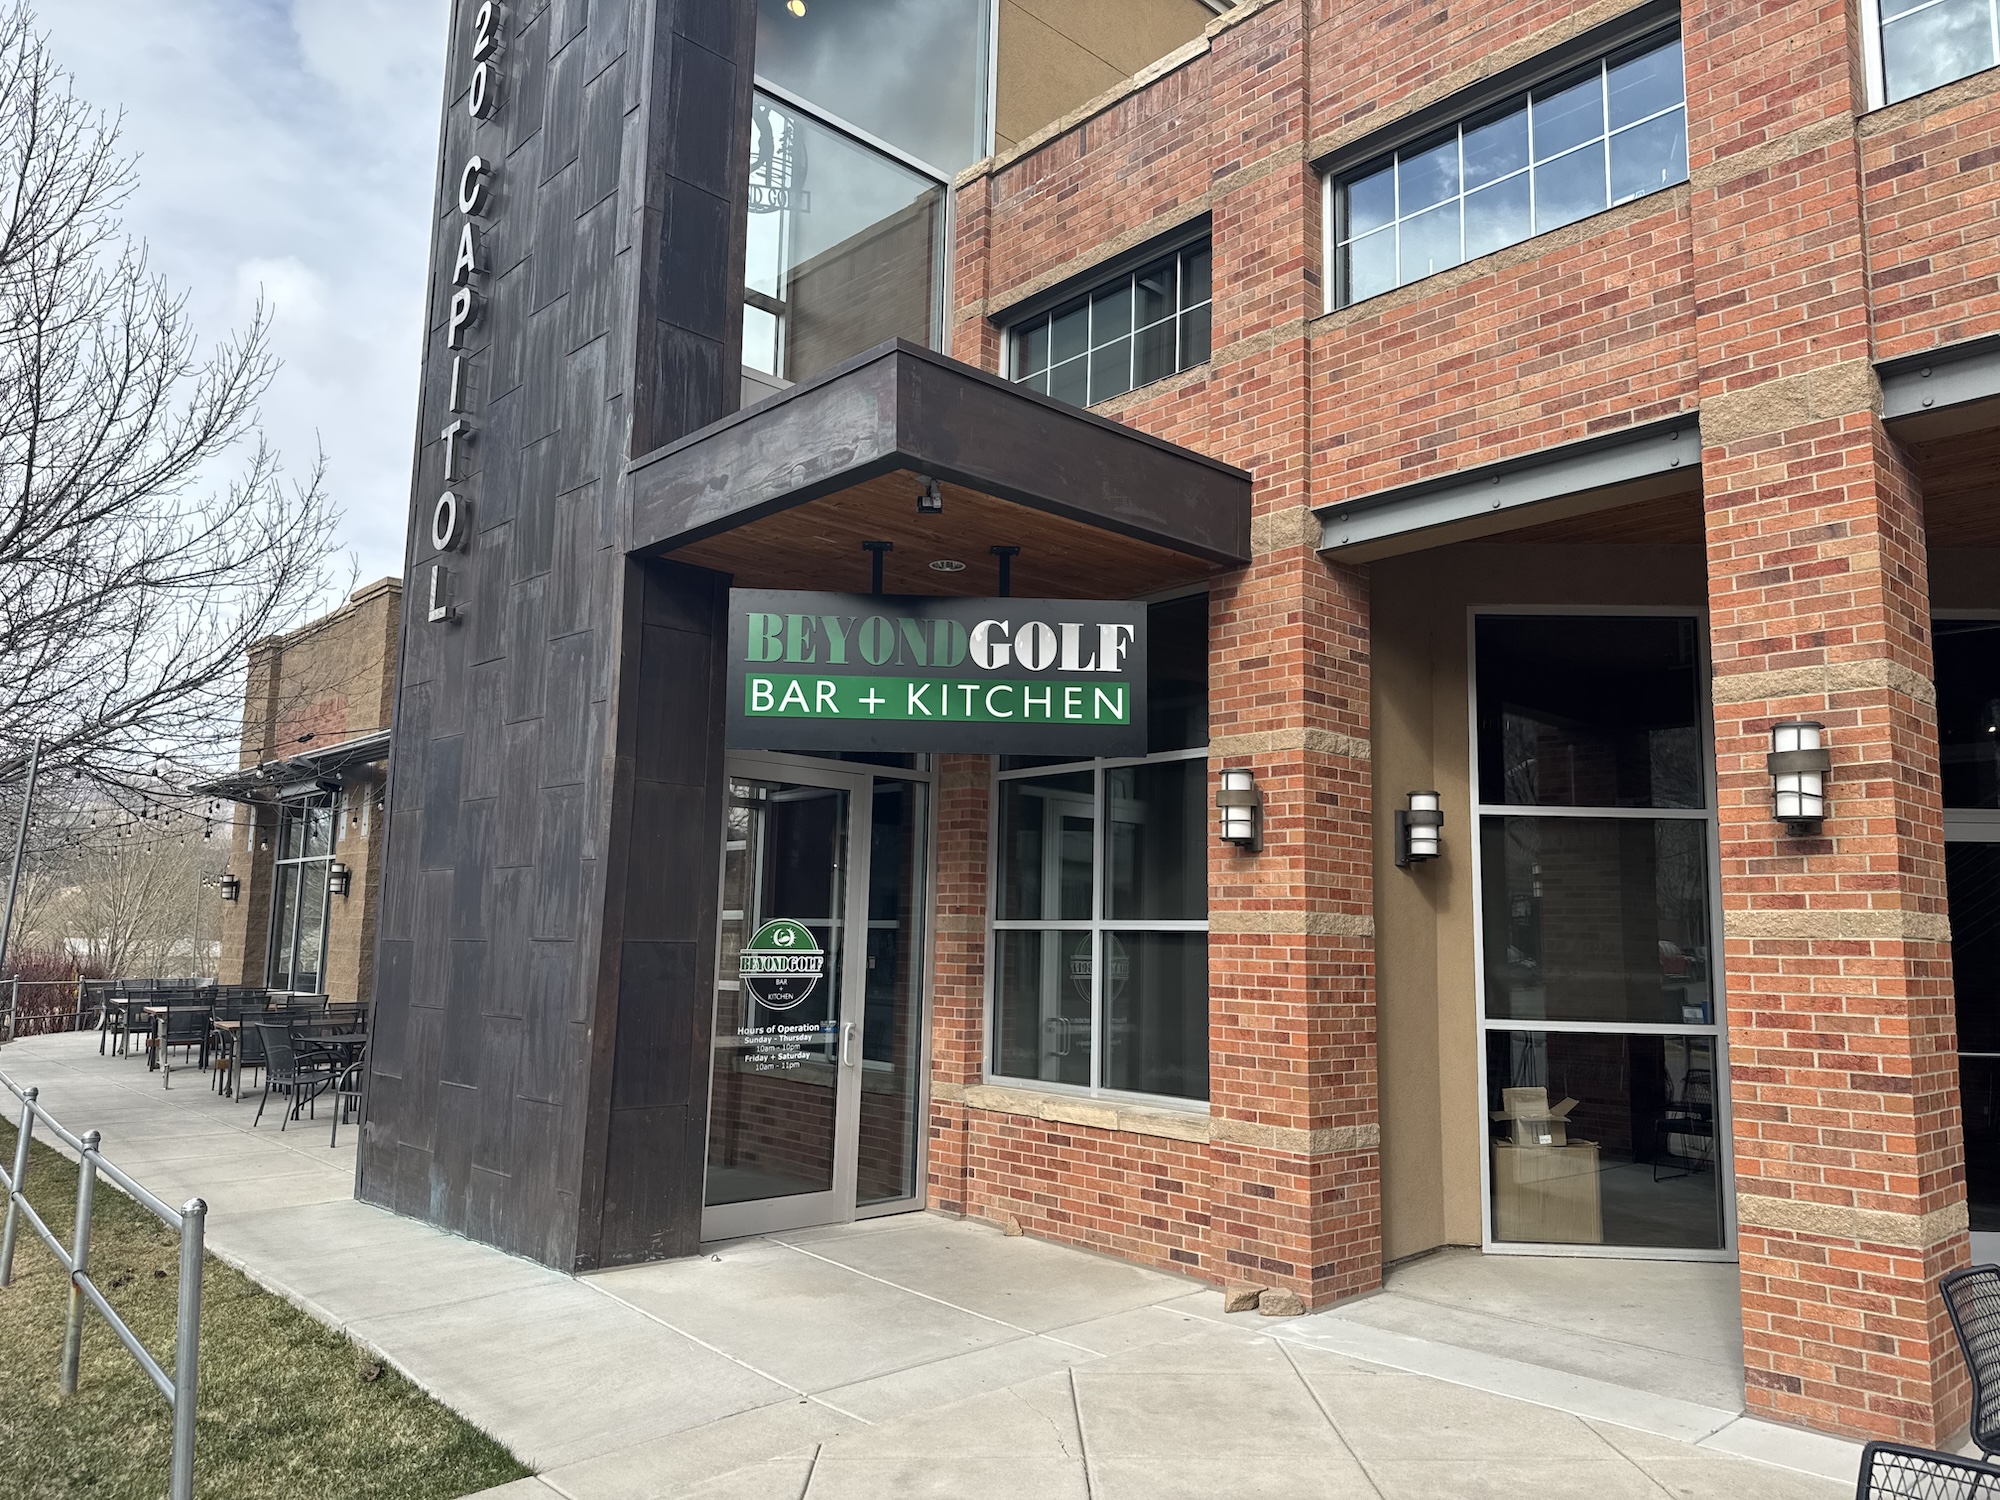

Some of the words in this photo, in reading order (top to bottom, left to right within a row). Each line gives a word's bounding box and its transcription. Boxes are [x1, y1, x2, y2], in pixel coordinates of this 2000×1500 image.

[469, 1, 497, 118] 20
[428, 155, 488, 623] CAPITOL
[751, 679, 840, 714] BAR
[858, 687, 886, 714] +
[907, 682, 1123, 720] KITCHEN
[738, 1027, 764, 1035] Hours
[766, 1025, 776, 1033] of
[777, 1024, 819, 1034] Operation
[744, 1036, 772, 1044] Sunday
[779, 1034, 813, 1042] Thursday
[756, 1045, 775, 1053] 10am
[782, 1043, 801, 1051] 10pm
[744, 1054, 769, 1063] Friday
[777, 1052, 811, 1060] Saturday
[755, 1063, 775, 1071] 10am
[781, 1061, 800, 1070] 11pm
